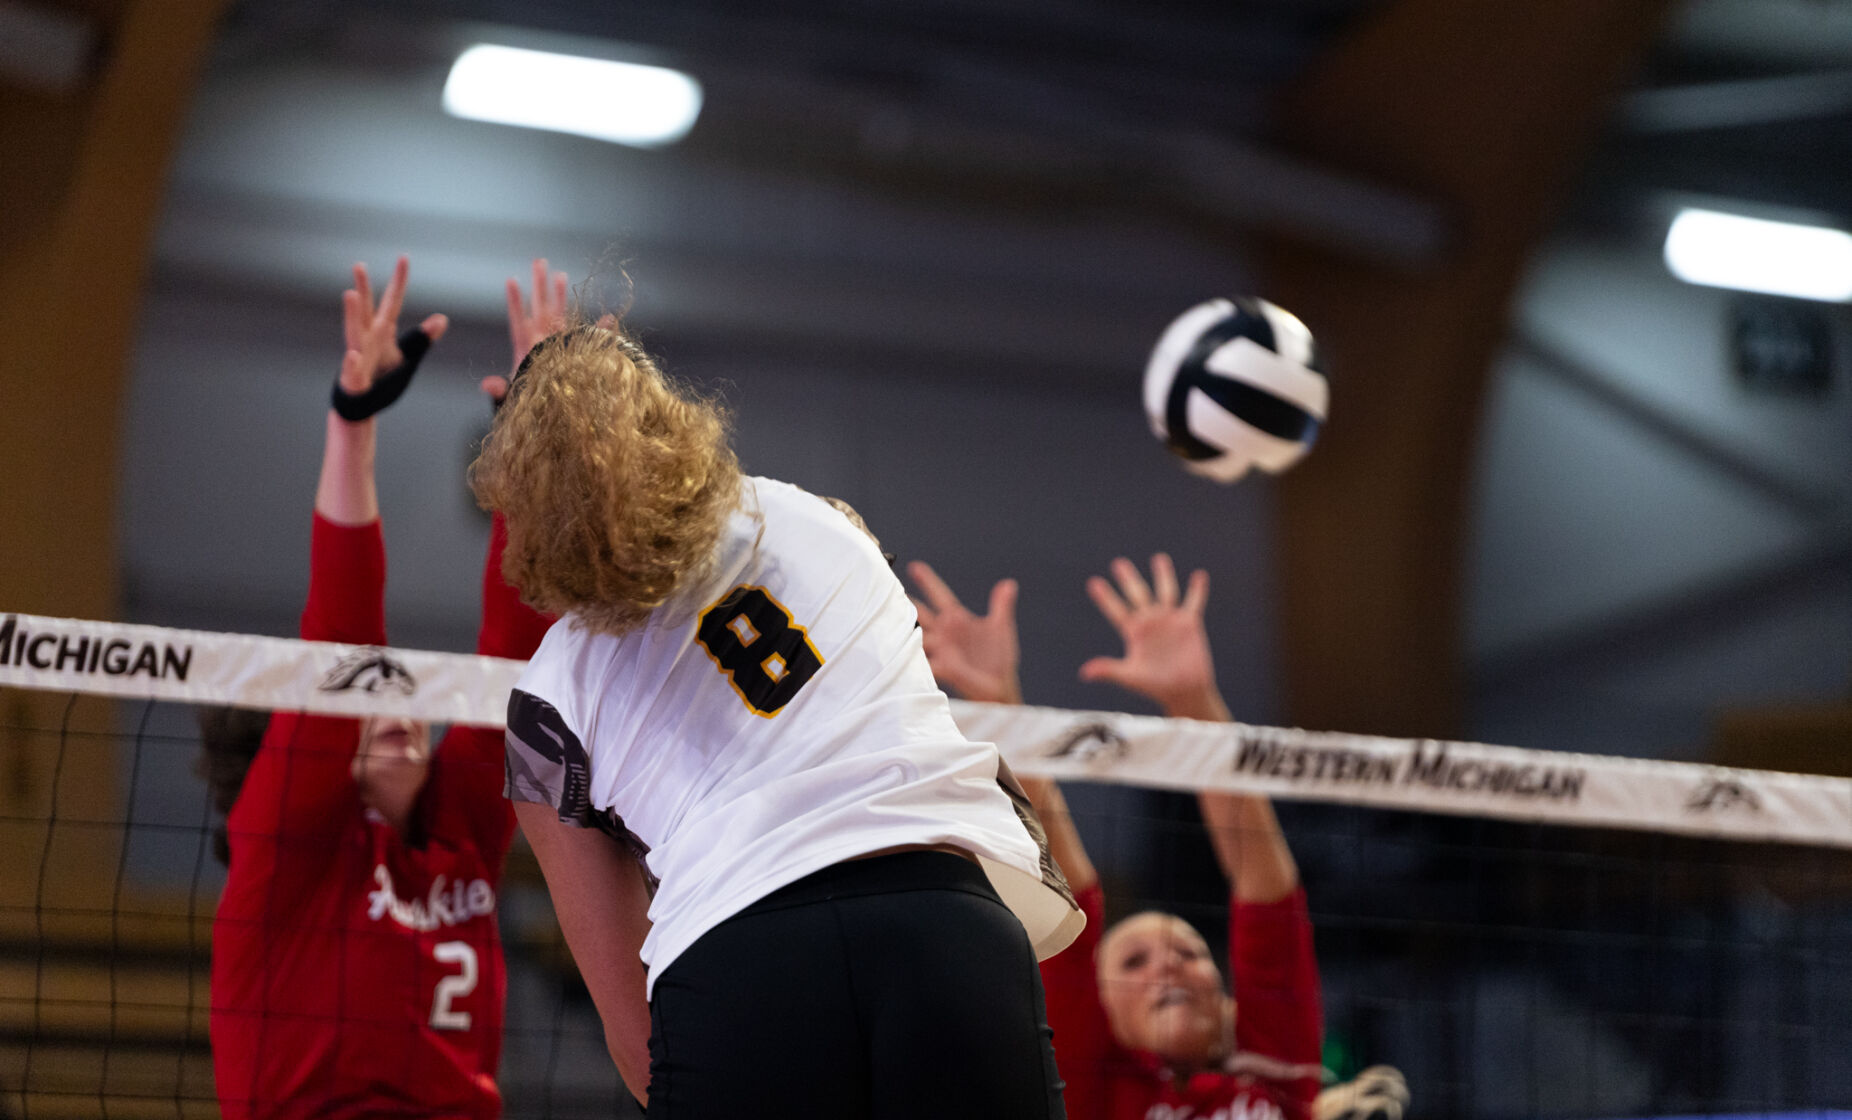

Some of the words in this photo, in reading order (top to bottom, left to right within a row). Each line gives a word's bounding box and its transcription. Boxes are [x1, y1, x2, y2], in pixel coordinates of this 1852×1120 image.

[694, 583, 826, 719] 8
[1234, 734, 1397, 784] WESTERN
[1406, 740, 1585, 801] MICHIGAN
[430, 941, 479, 1031] 2
